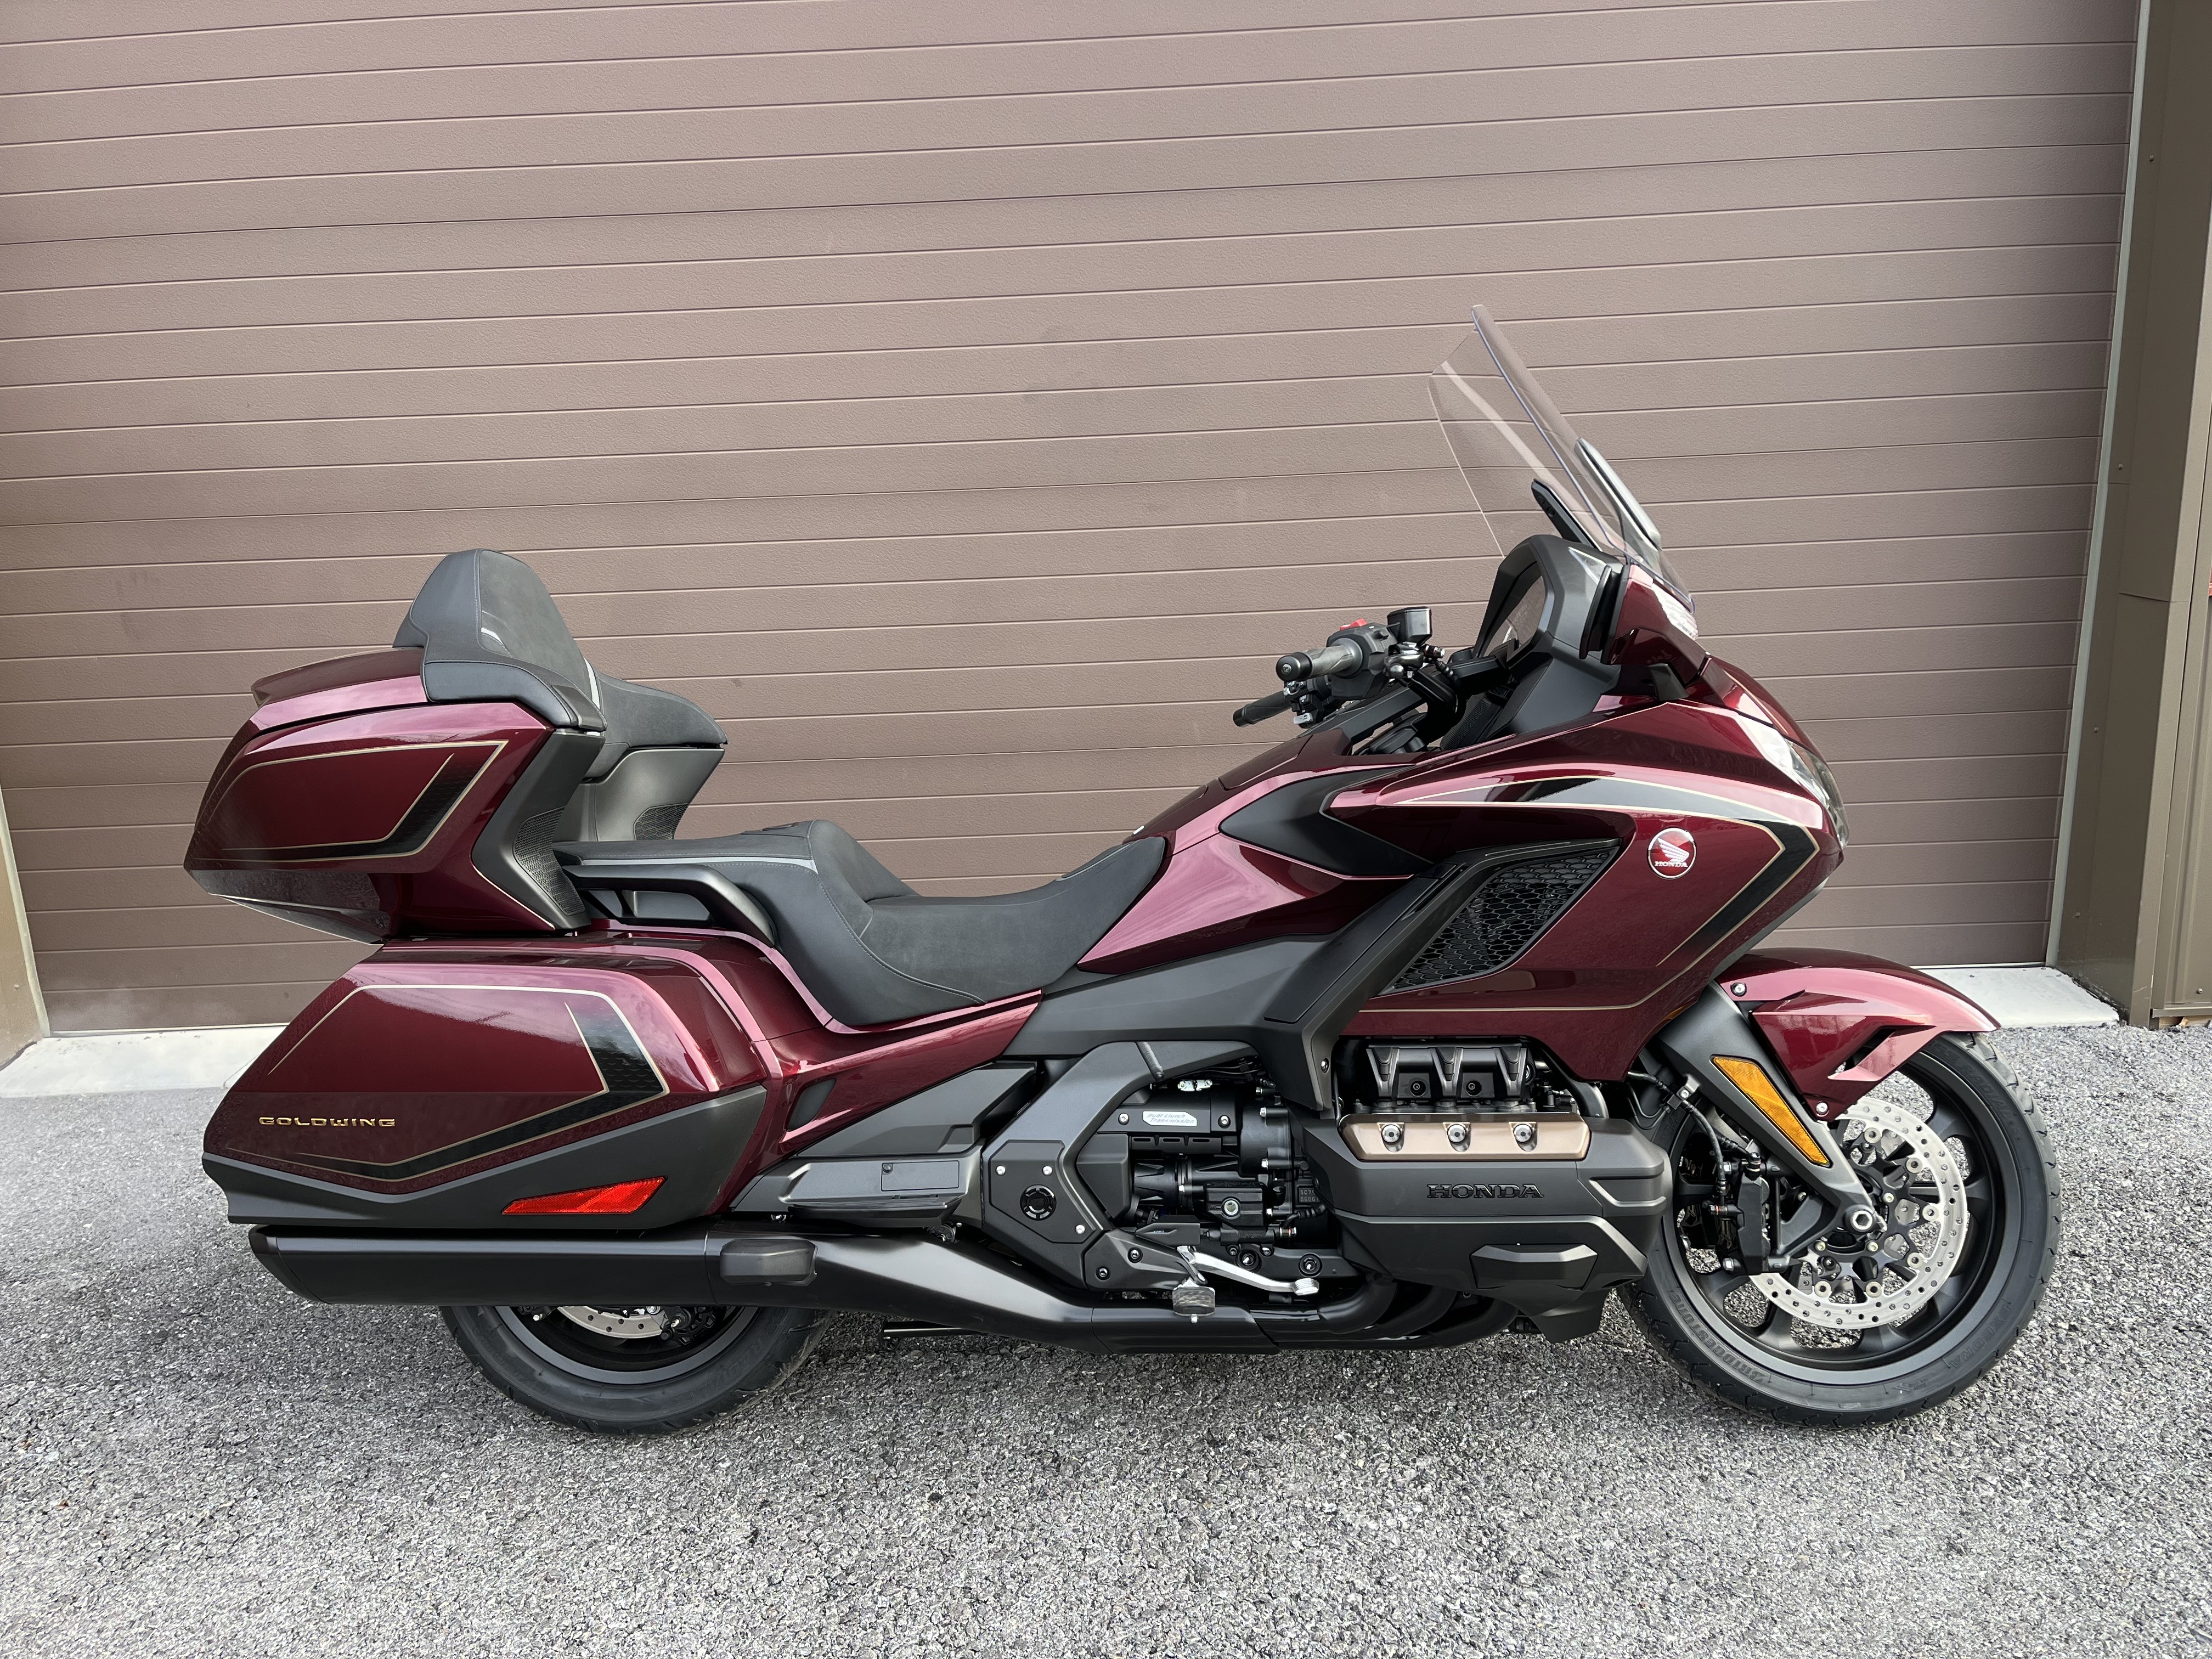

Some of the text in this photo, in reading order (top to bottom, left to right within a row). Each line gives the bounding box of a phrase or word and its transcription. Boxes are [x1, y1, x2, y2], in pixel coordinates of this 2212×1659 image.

[258, 1116, 396, 1127] GOLDWING
[1427, 1183, 1545, 1199] HONDA
[1669, 1293, 1770, 1385] BRIDGESTONE
[1949, 1304, 2012, 1369] EXEDRA
